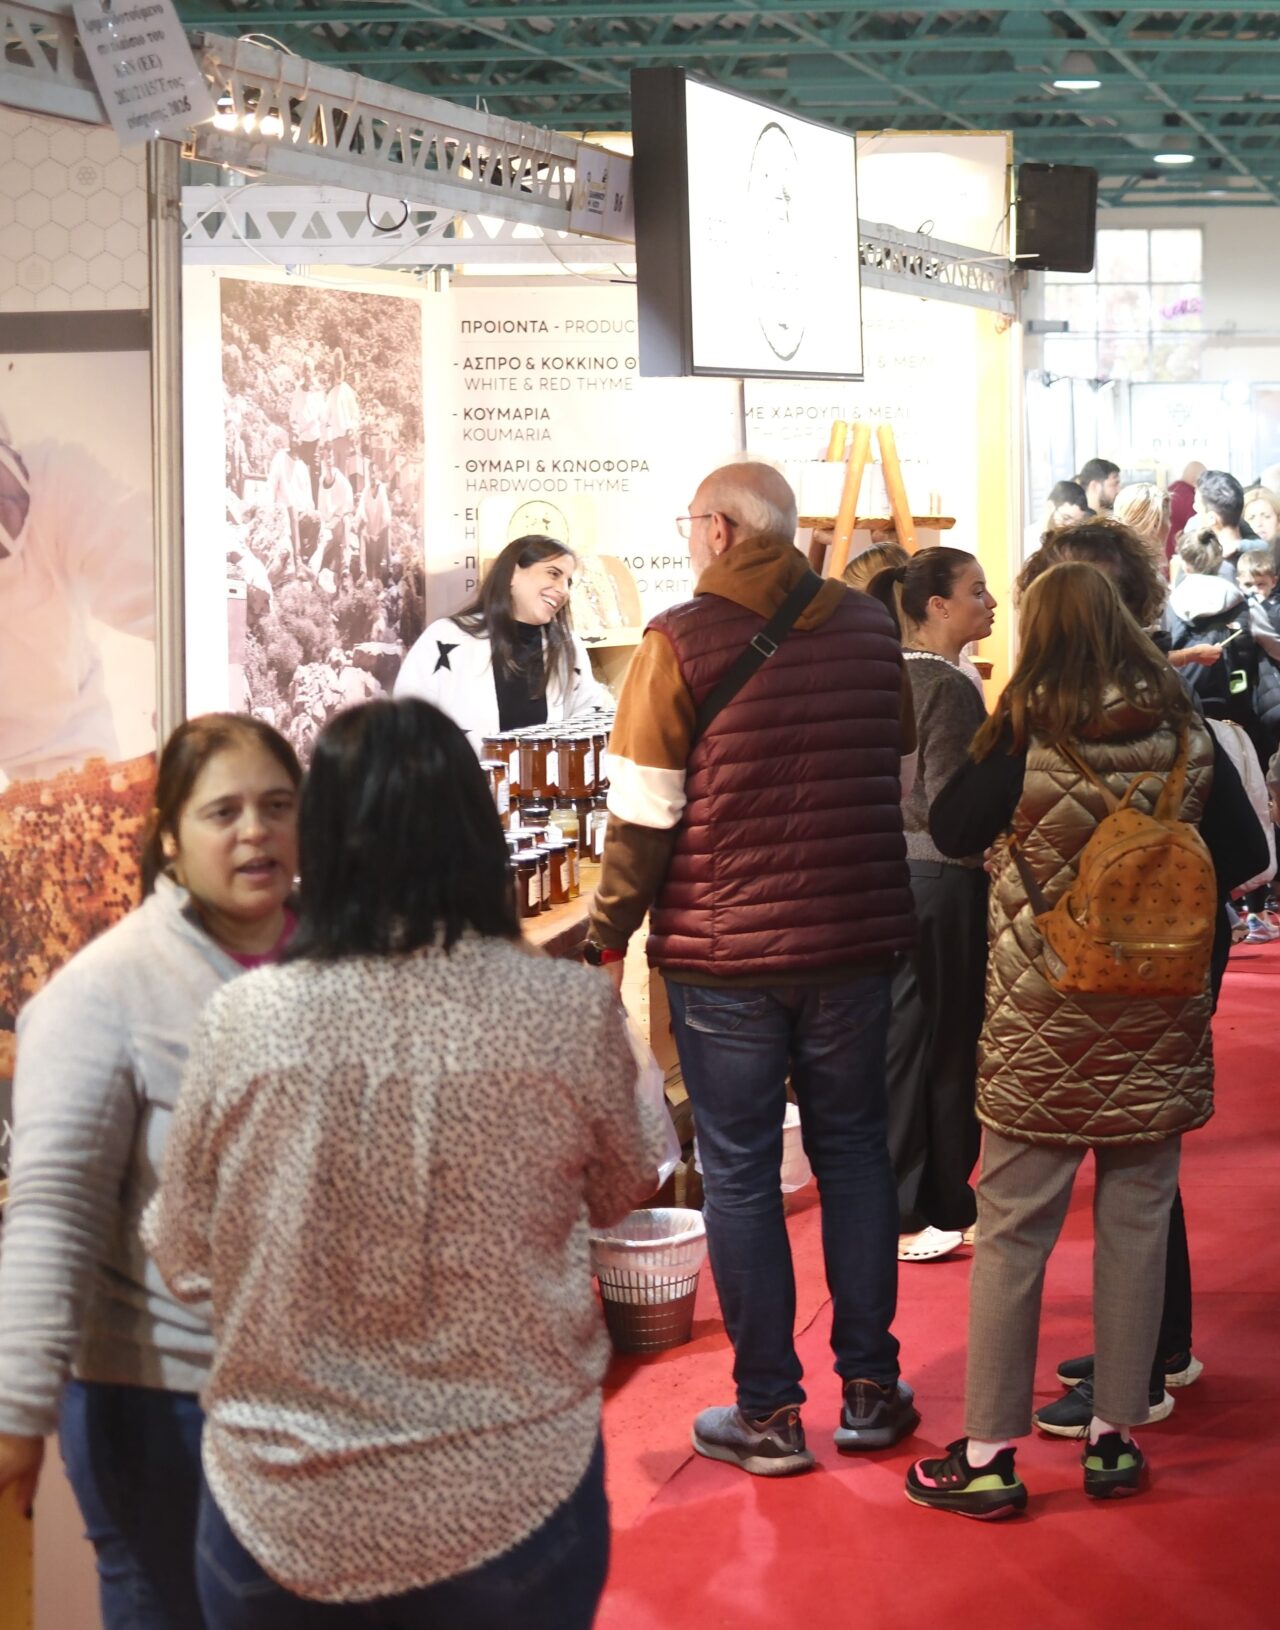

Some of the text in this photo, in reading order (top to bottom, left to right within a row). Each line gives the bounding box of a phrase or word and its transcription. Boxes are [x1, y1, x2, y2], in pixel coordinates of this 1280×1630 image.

[461, 320, 549, 334] ΠΡΟΙΟΝΤΑ
[565, 319, 637, 334] PRODUC
[463, 356, 521, 370] ΑΣΠΡΟ
[525, 356, 536, 370] &
[541, 356, 619, 370] ΚΟΚΚΙΝΟ
[464, 377, 633, 391] WHITE & RED THYME
[463, 407, 551, 421] ΚΟΥΜΑΡΙΑ
[771, 406, 846, 420] ΧΑΡΟΥΠΙ
[463, 427, 552, 442] KOUMARIA
[465, 459, 530, 473] ΘΥΜΑΡΙ
[536, 459, 546, 473] &
[552, 459, 650, 473] ΚΩΝΟΦΟΡΑ
[466, 478, 630, 492] HARDWOOD THYME
